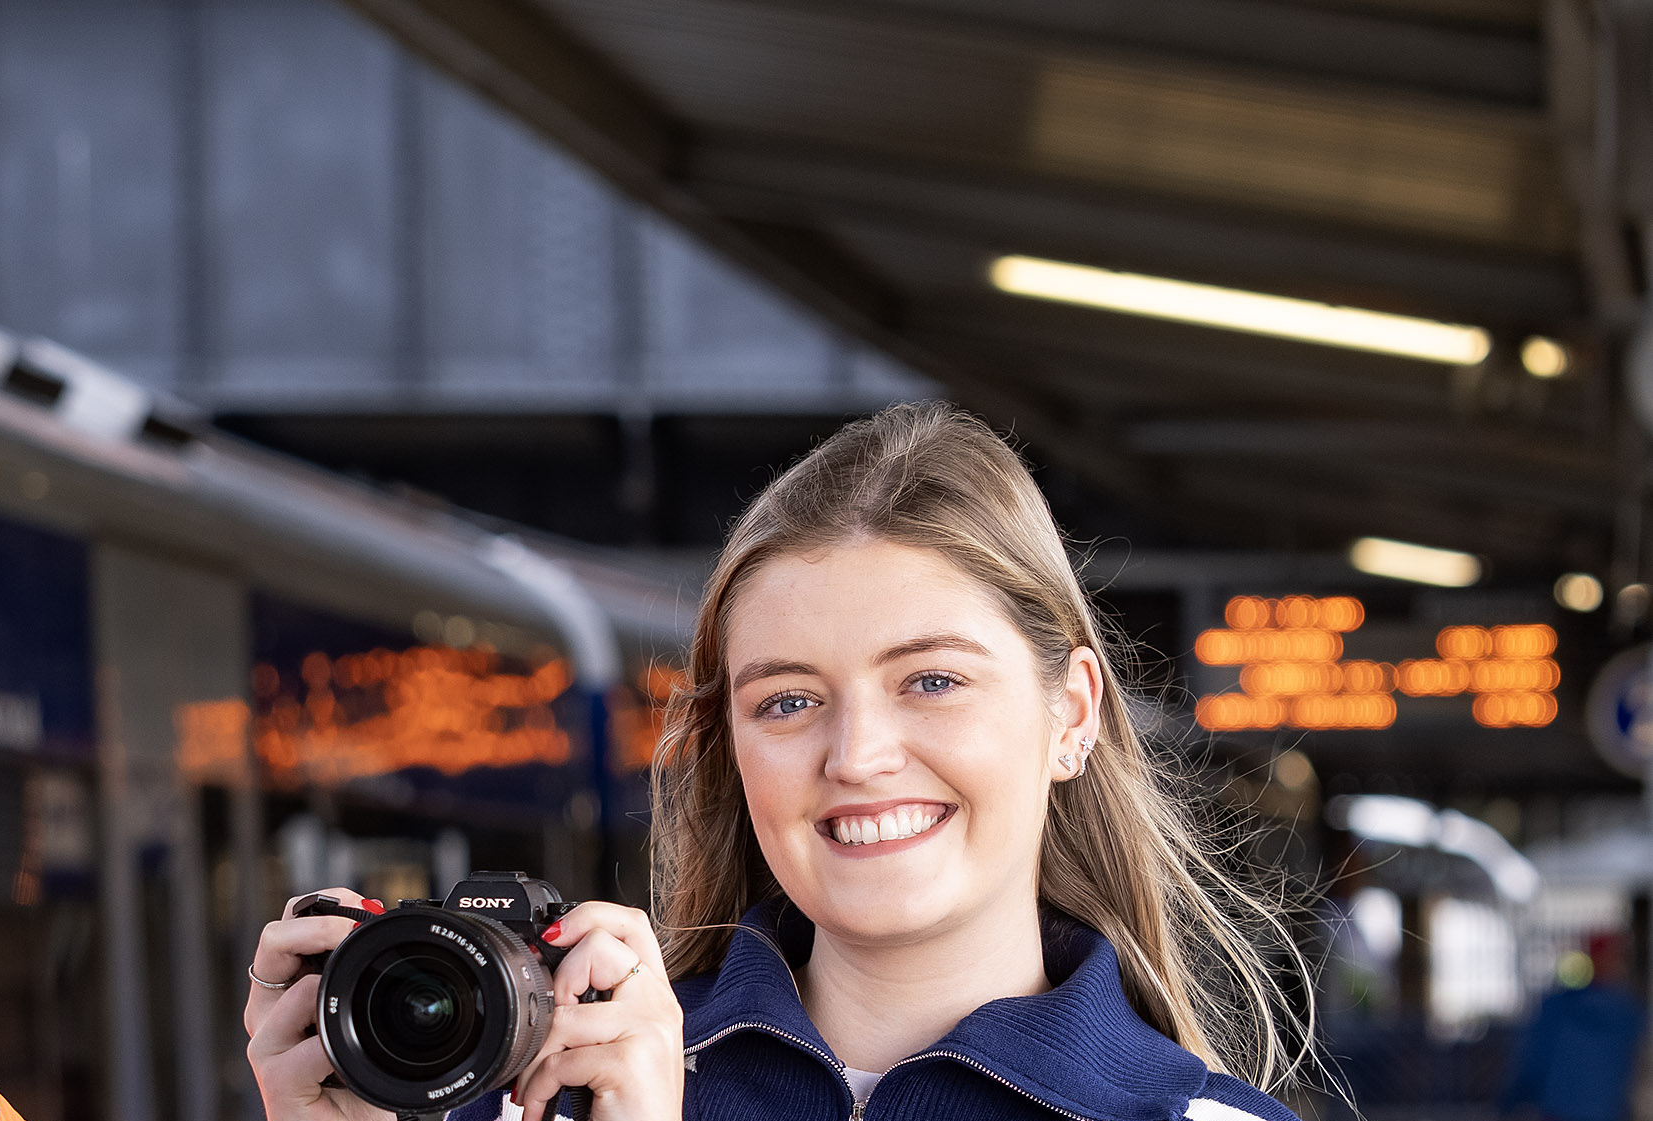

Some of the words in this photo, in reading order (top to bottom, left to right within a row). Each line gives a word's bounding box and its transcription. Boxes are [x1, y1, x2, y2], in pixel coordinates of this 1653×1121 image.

[459, 897, 515, 909] SONY
[430, 924, 442, 934] FE
[474, 952, 488, 967] GM
